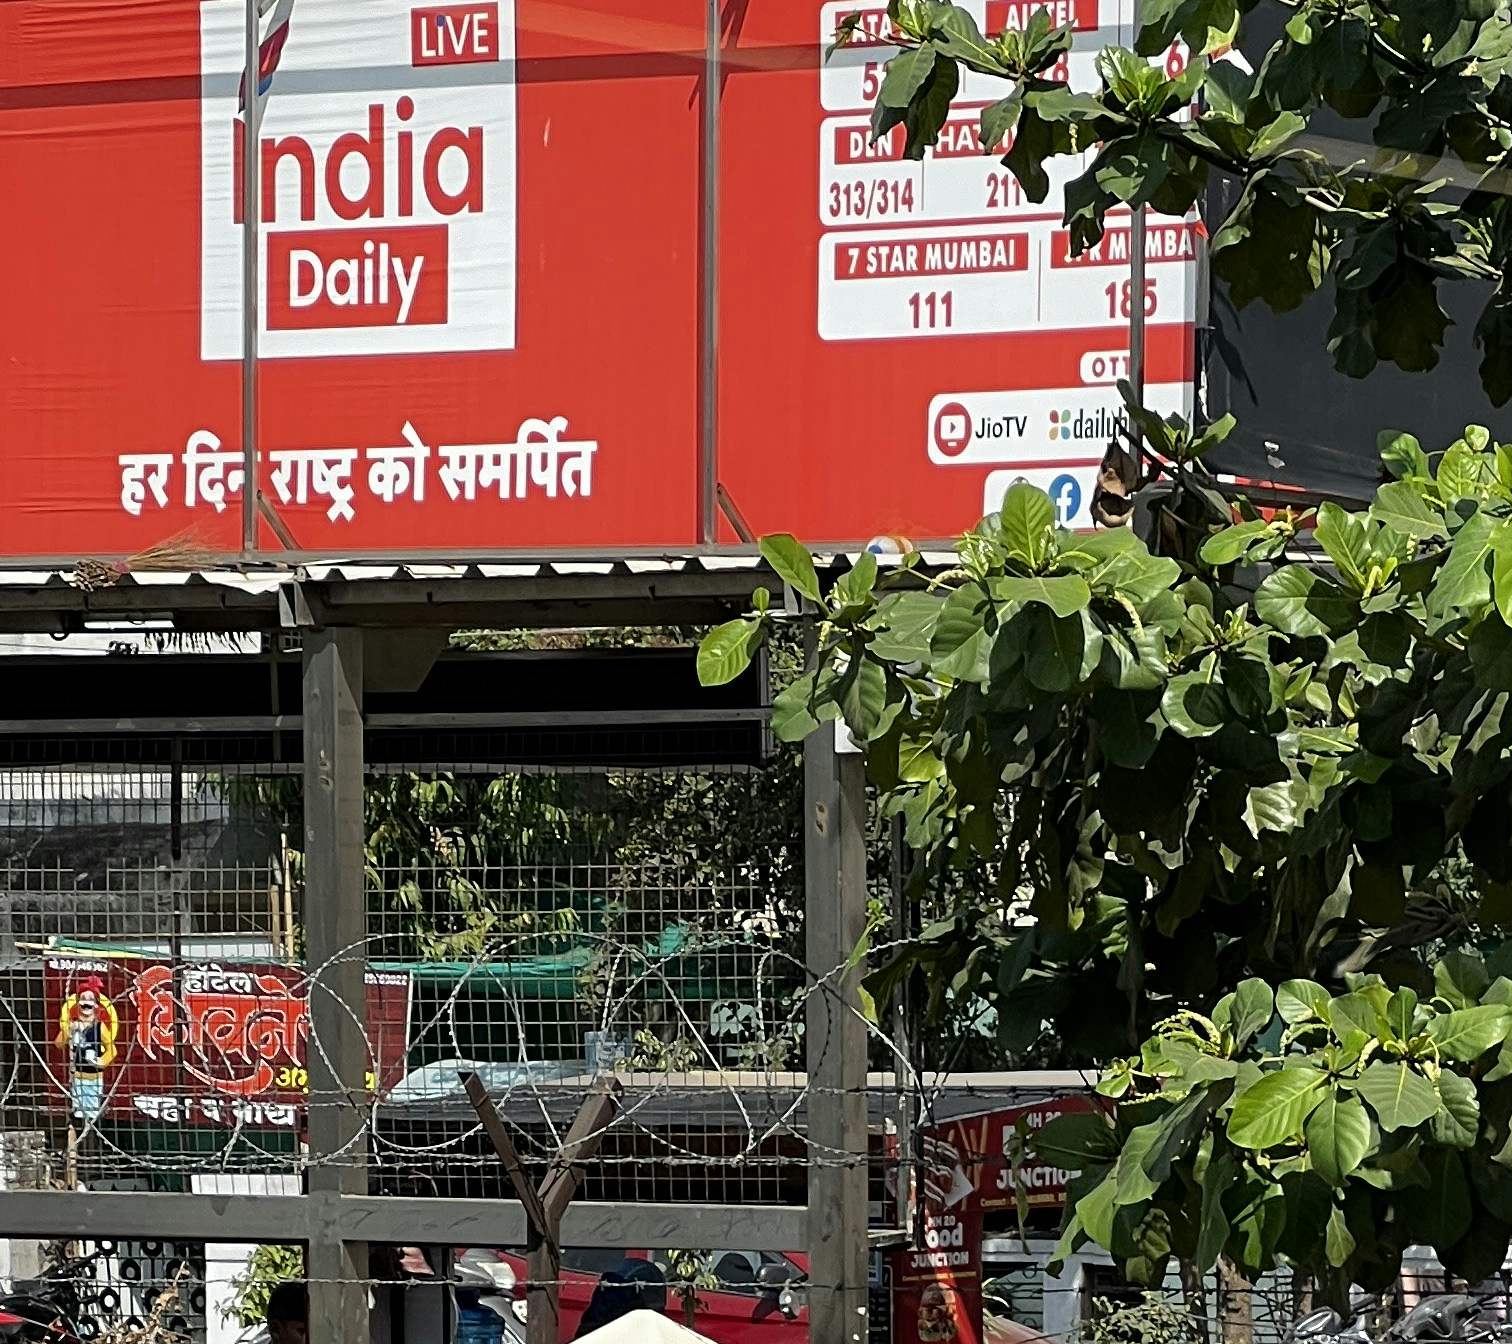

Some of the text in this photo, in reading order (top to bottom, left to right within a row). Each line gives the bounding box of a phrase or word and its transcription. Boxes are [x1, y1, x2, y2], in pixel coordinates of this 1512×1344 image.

[233, 95, 483, 224] India
[829, 178, 914, 218] 313/314
[848, 239, 1016, 275] 7 STAR MUMBAI
[289, 240, 424, 324] Daily
[909, 291, 952, 328] 111
[975, 415, 1027, 439] JioTV
[118, 454, 173, 516] हर
[270, 448, 358, 522] राष्ट्र
[366, 420, 430, 502] को
[439, 415, 598, 499] समर्पित
[925, 1221, 963, 1249] ood
[910, 1251, 969, 1268] JUNCTION
